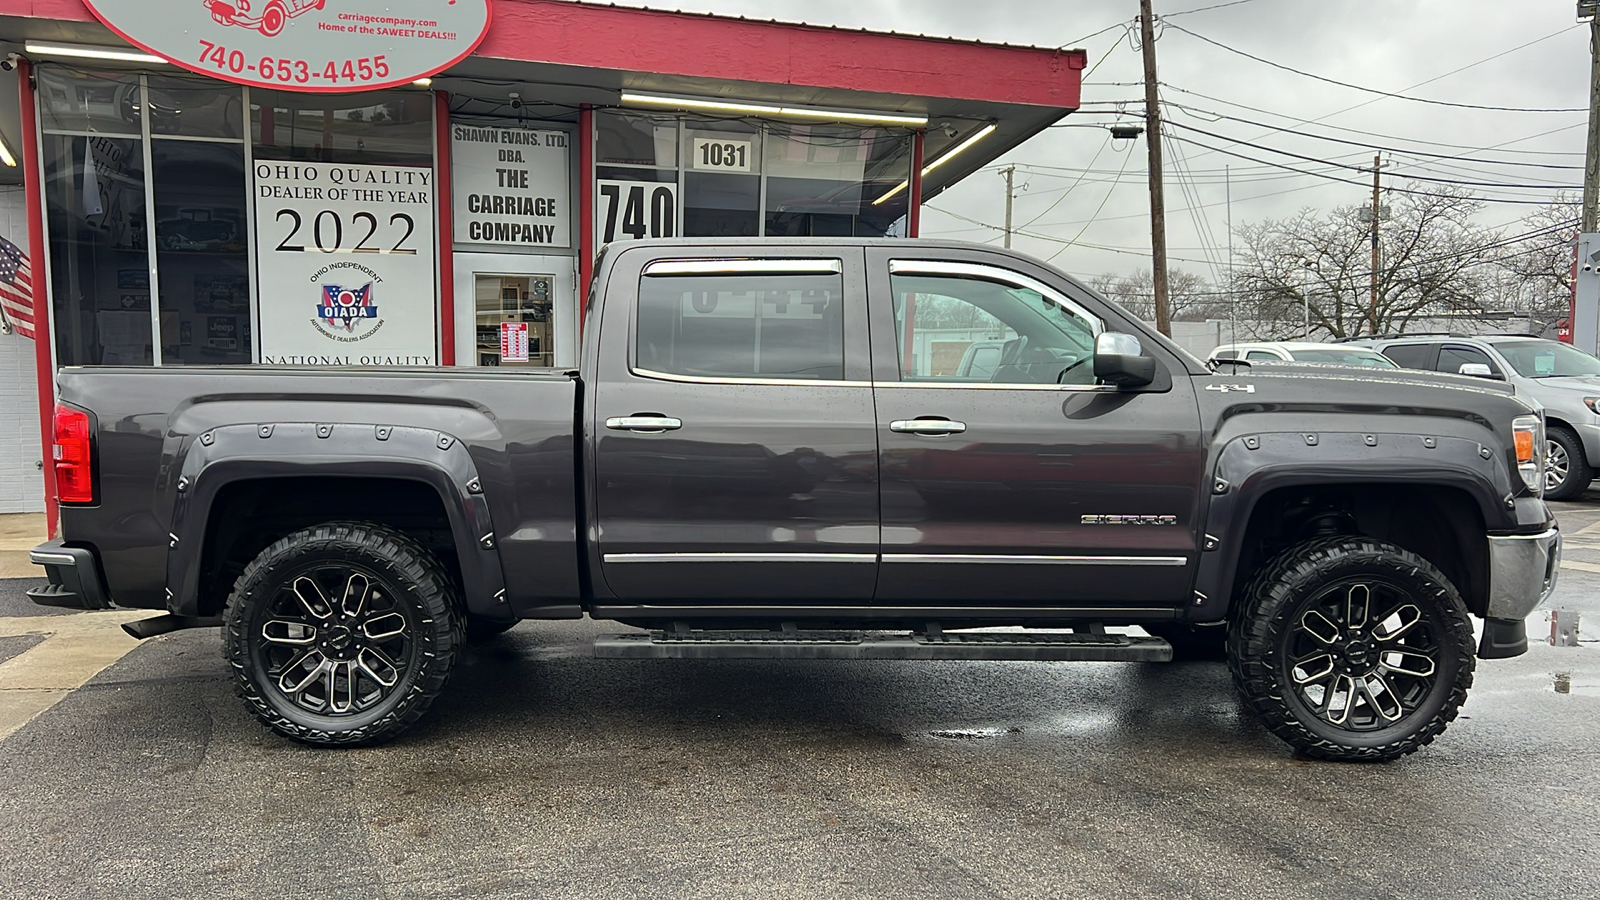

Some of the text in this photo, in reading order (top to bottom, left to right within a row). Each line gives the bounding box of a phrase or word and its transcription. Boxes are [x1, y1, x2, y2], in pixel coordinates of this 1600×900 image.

[318, 22, 457, 40] Home of the SAWEET DEALS!!!
[338, 12, 437, 28] carriagecompany.com
[198, 39, 390, 84] 740-653-4455
[454, 127, 568, 149] SHAWN EVANS. LTD.
[498, 149, 526, 164] DBA.
[700, 142, 745, 168] 1031
[256, 164, 431, 186] OHIO QUALITY
[496, 168, 529, 189] THE
[260, 185, 429, 204] DEALER OF THE YEAR
[468, 193, 556, 217] CARRIAGE
[600, 184, 674, 243] 740
[275, 208, 418, 255] 2022
[469, 220, 555, 244] COMPANY
[310, 261, 384, 284] OHIO INDEPENDENT
[324, 306, 368, 318] OIADA
[210, 322, 234, 333] Jeep
[310, 318, 336, 341] AUTOMOBILE
[359, 318, 385, 341] ASSOCIATION
[265, 356, 352, 365] NATIONAL
[1080, 514, 1177, 526] SIERRA
